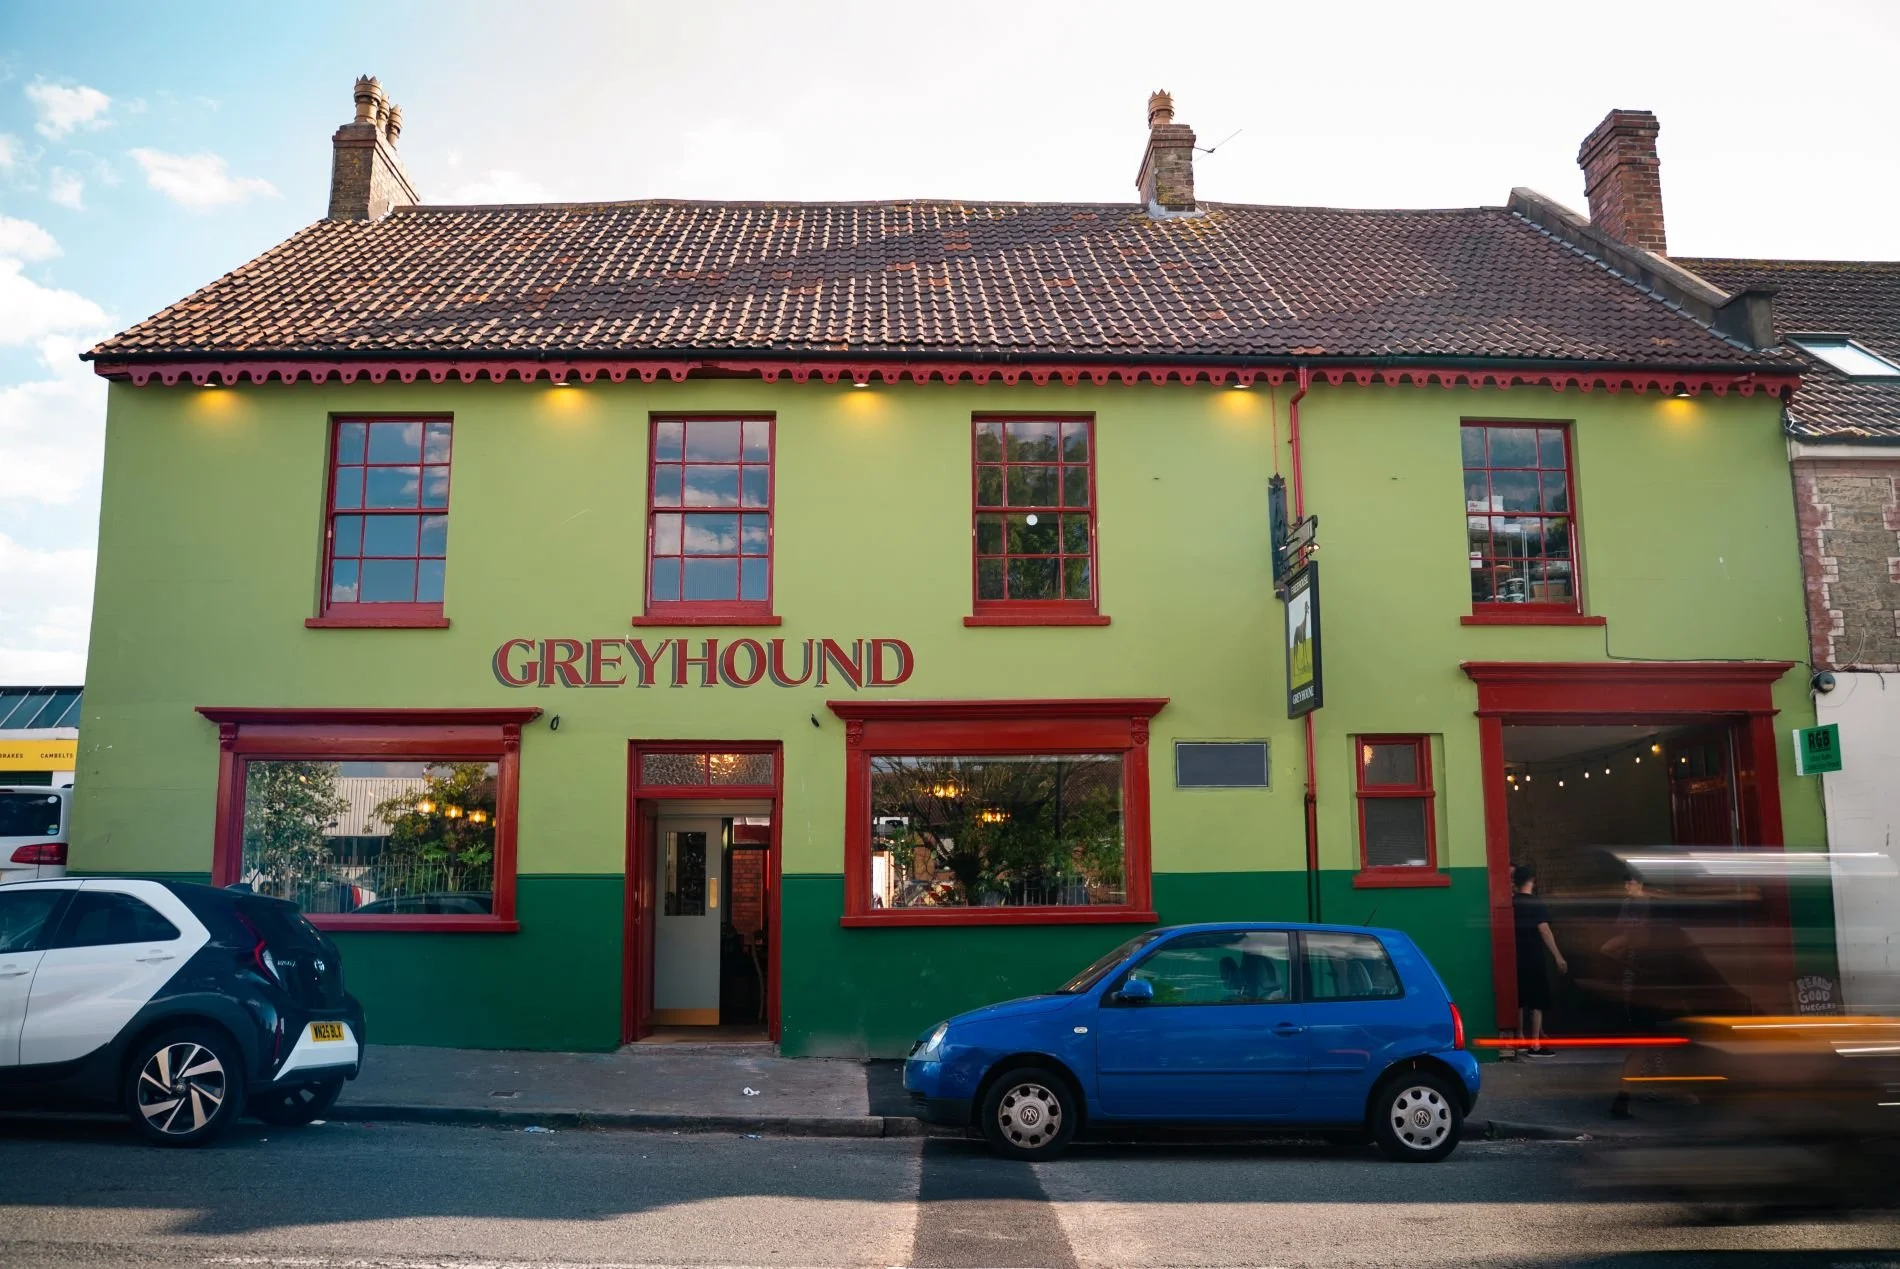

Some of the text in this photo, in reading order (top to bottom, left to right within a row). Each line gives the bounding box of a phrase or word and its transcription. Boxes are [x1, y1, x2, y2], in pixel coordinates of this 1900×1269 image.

[492, 638, 915, 692] GREYHOUND
[1808, 730, 1830, 750] RGB
[1798, 990, 1831, 1004] GOOD
